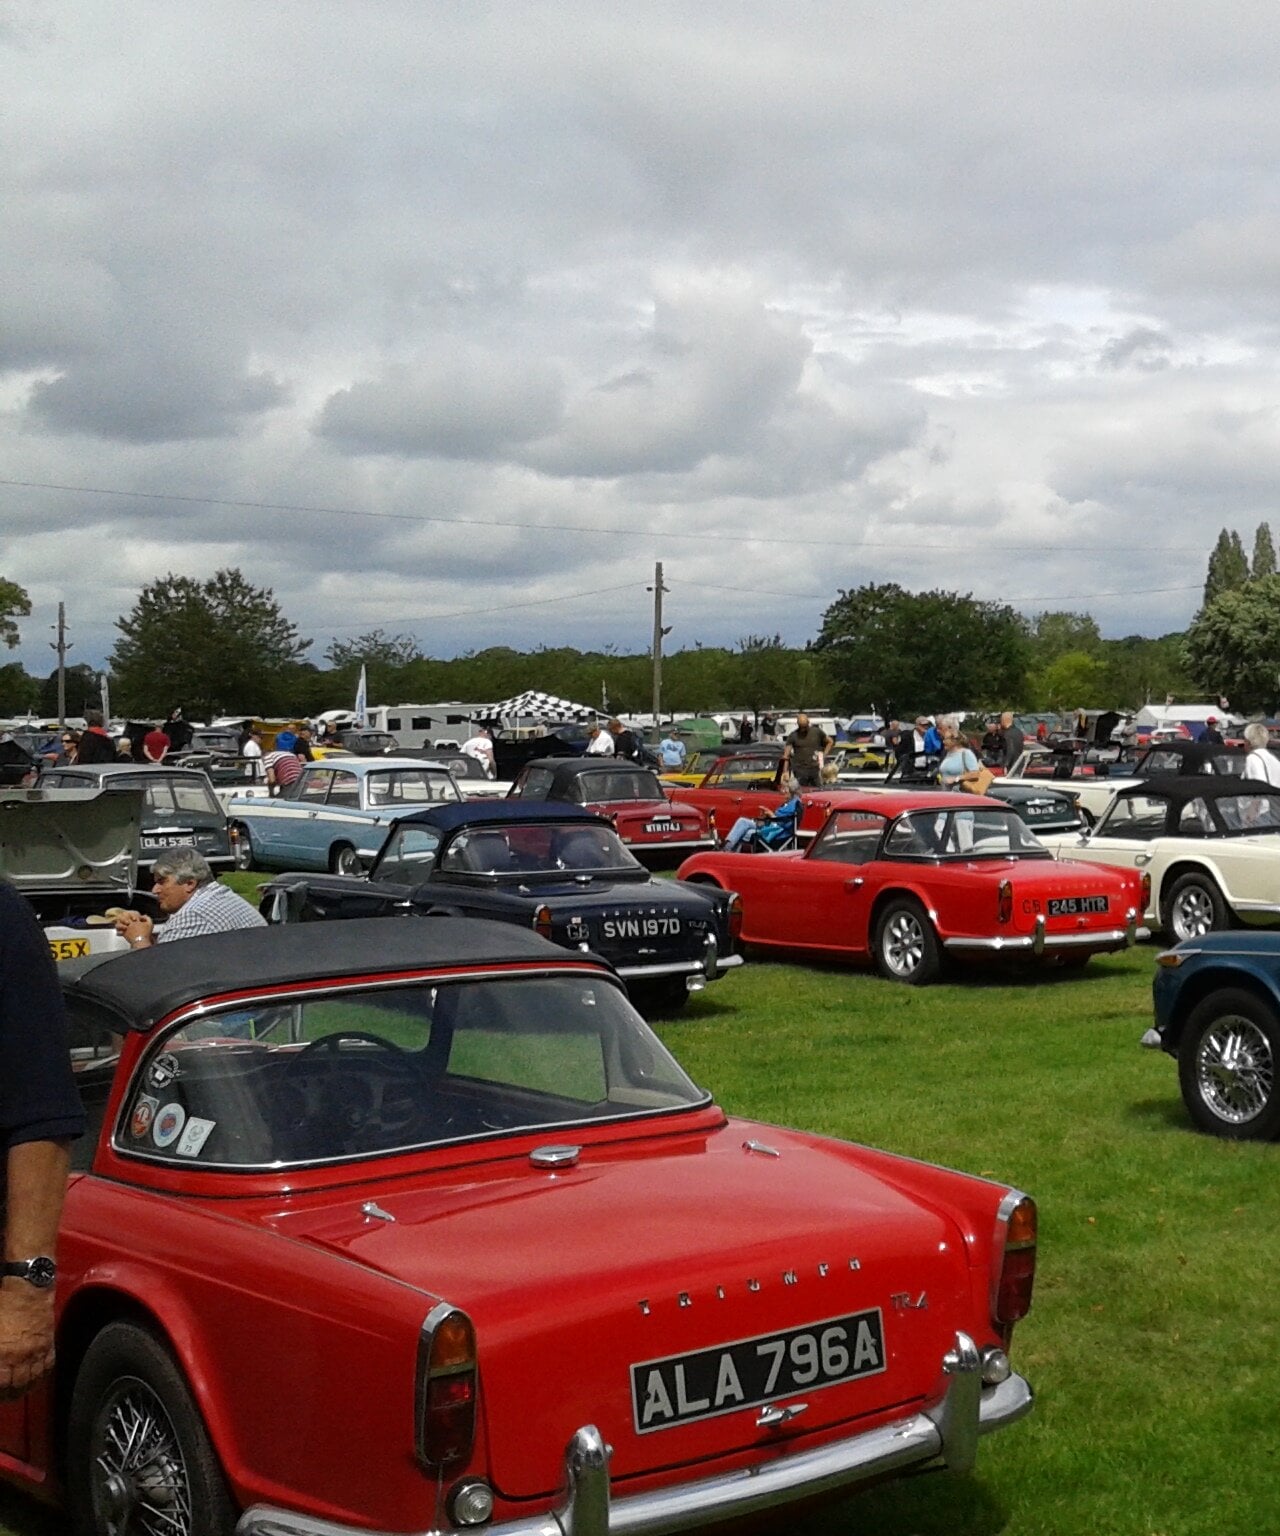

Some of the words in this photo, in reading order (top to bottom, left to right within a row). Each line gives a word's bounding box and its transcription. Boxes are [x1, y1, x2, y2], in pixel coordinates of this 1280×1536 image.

[1051, 900, 1077, 915] 245
[1081, 897, 1106, 912] HTR
[603, 920, 639, 938] SVN
[642, 918, 680, 935] 197D
[638, 1257, 862, 1315] TRIUMPH
[643, 1353, 744, 1424] ALA
[756, 1320, 880, 1394] 796A
